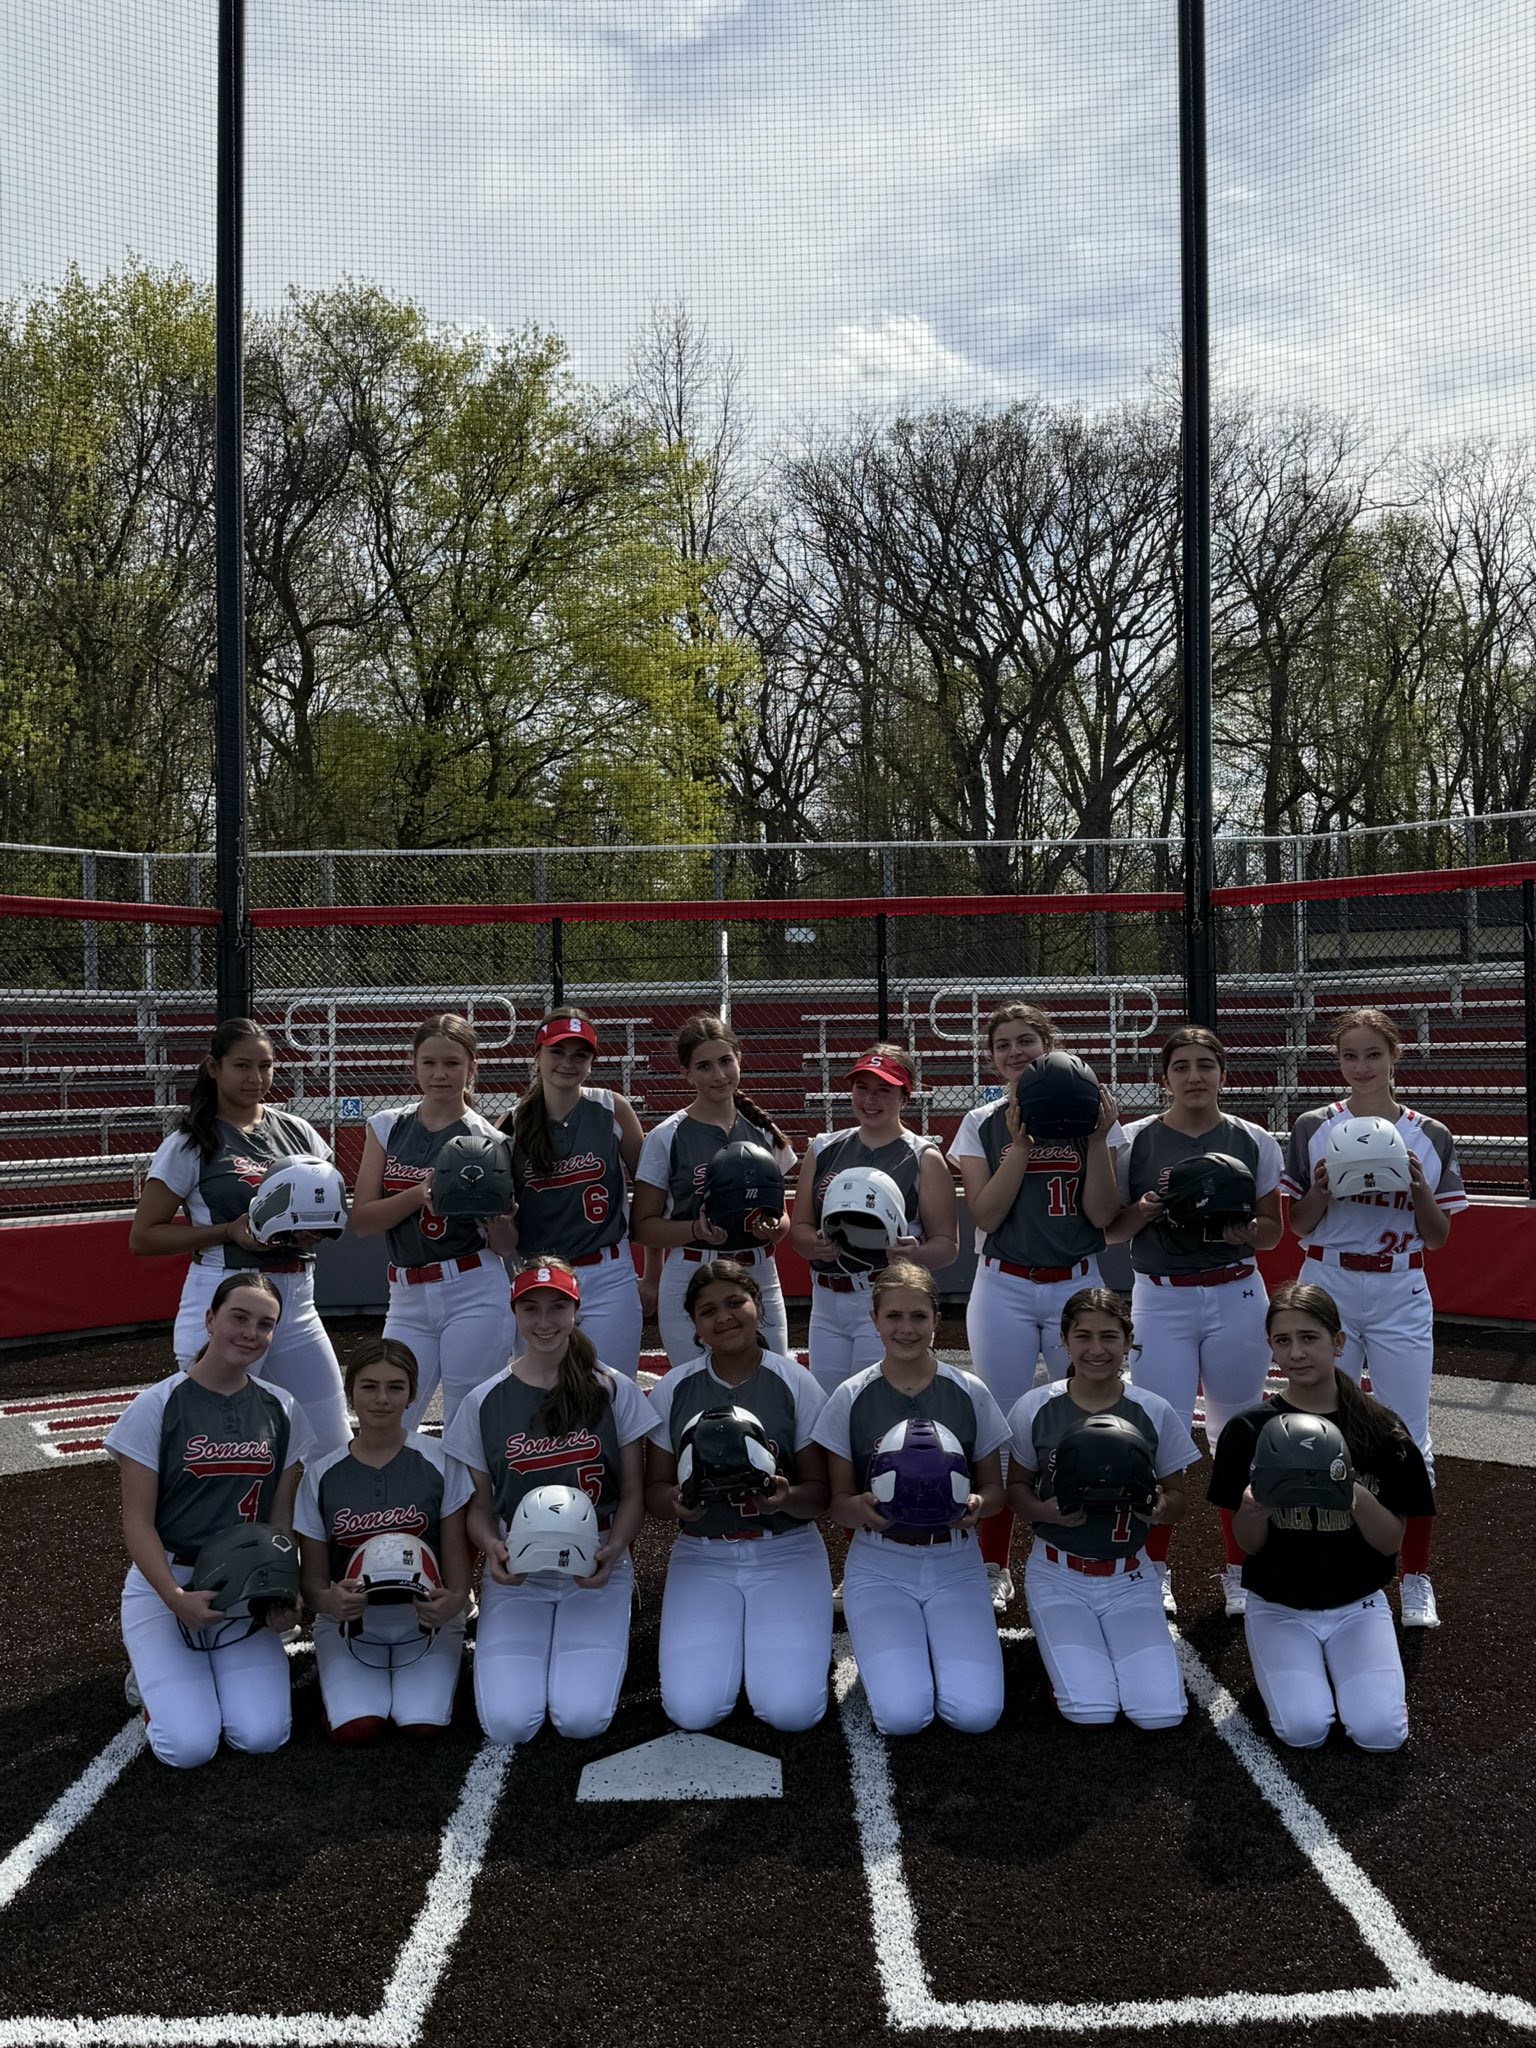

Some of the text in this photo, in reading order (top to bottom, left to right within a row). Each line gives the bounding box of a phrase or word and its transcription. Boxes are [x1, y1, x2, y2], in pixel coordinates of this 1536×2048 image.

[569, 1018, 582, 1033] S
[869, 1056, 883, 1067] S
[582, 1184, 609, 1224] 6
[1047, 1176, 1079, 1216] 11
[535, 1267, 551, 1282] S
[183, 1434, 272, 1461] Somers
[577, 1464, 604, 1507] 5
[237, 1480, 263, 1523] 4
[332, 1504, 418, 1535] Somers
